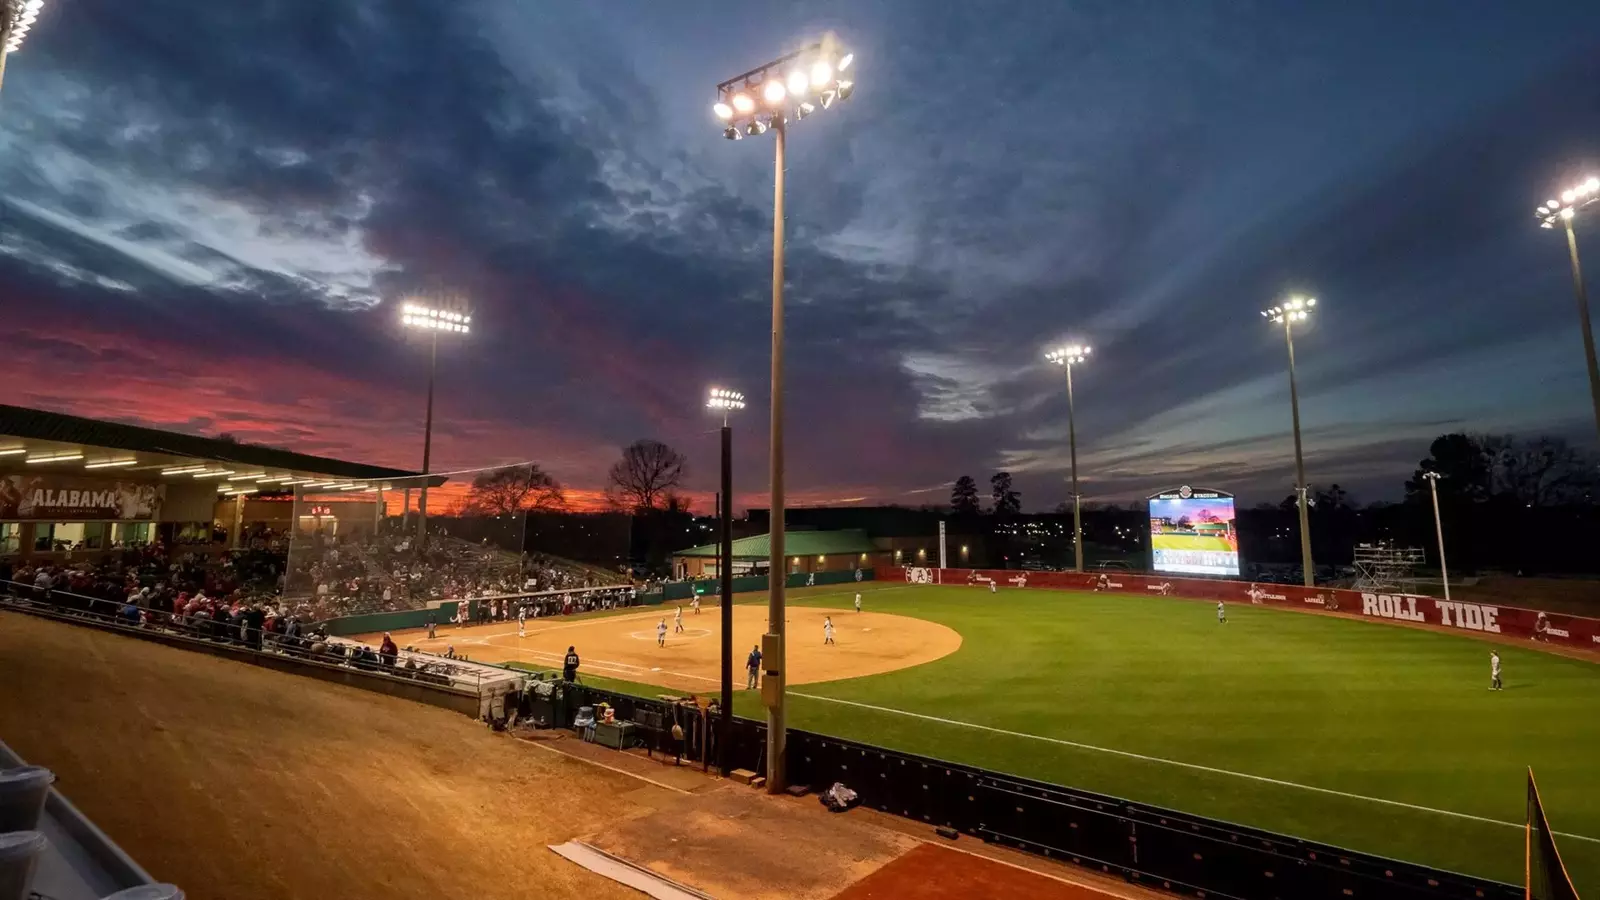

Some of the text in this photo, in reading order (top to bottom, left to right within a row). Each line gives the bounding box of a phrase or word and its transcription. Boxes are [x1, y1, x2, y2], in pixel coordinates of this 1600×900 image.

[32, 488, 116, 508] ALABAMA
[1361, 593, 1501, 633] ROLL TIDE
